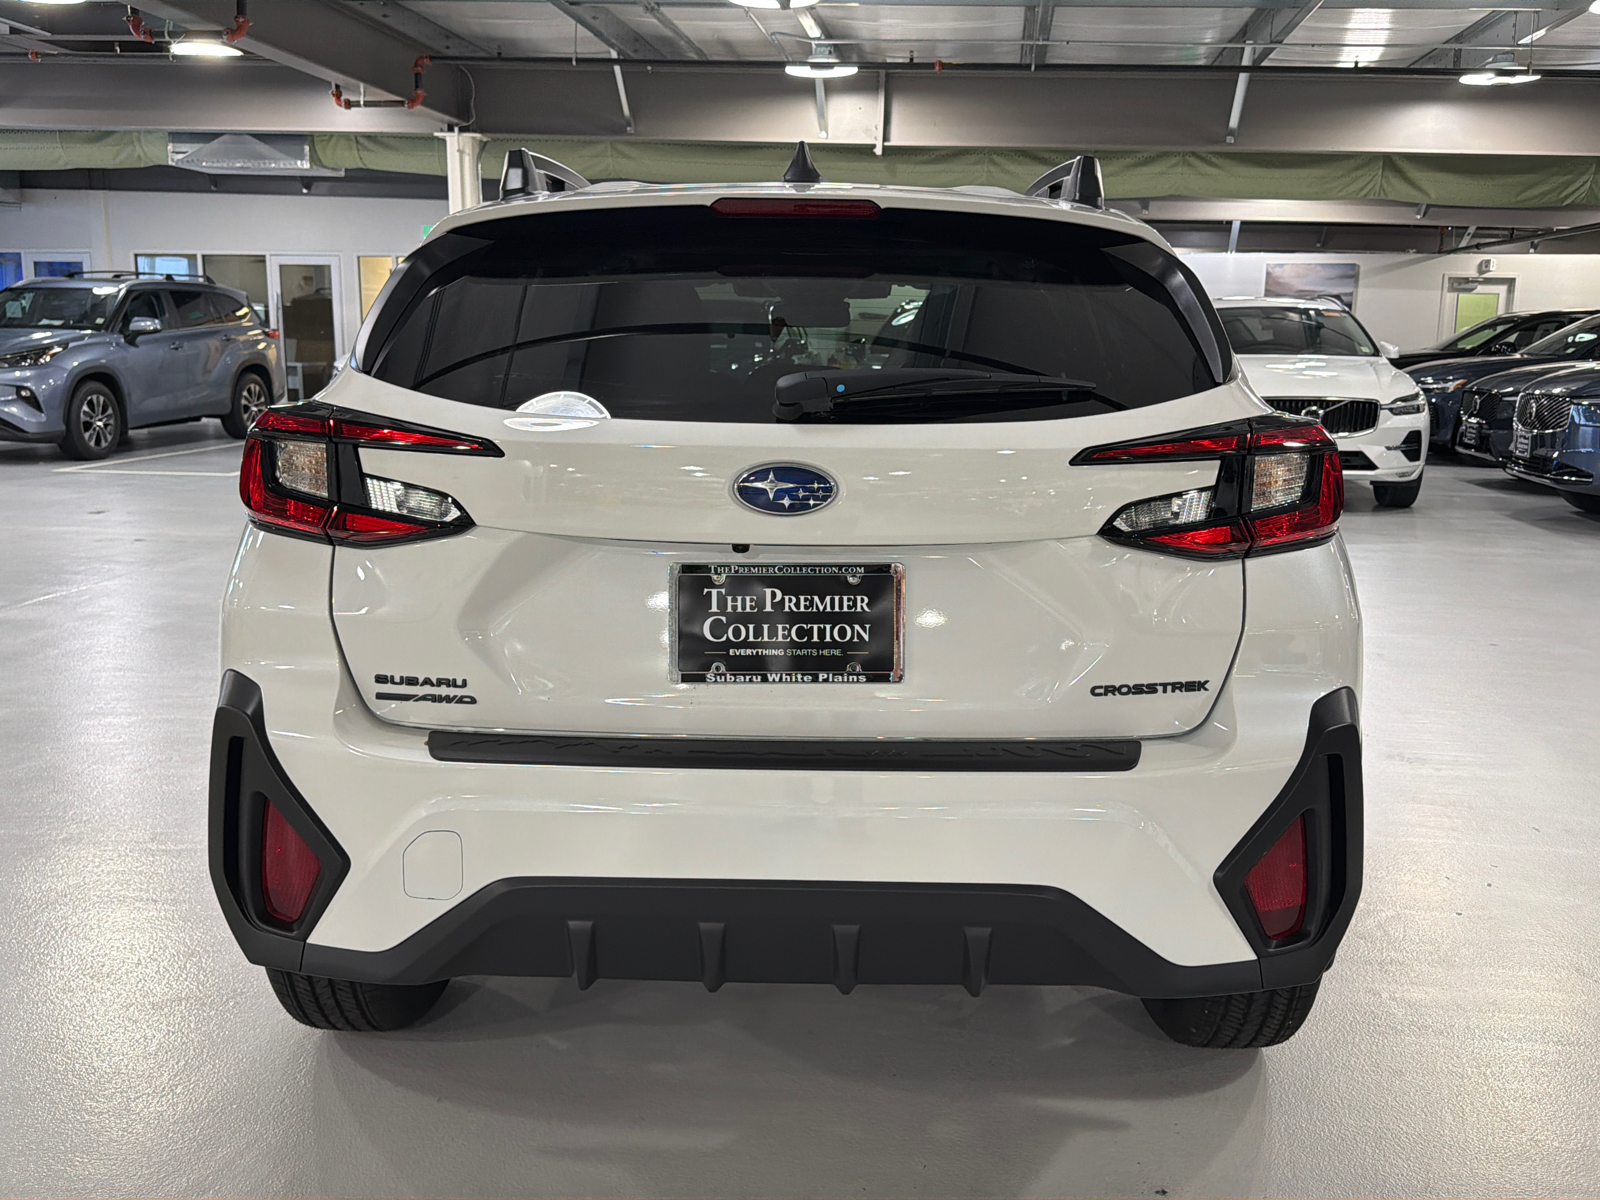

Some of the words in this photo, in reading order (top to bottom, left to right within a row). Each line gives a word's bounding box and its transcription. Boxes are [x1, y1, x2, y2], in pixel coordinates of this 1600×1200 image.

[703, 588, 757, 612] THE
[763, 588, 870, 612] PREMIER
[703, 616, 870, 642] COLLECTION
[374, 674, 467, 688] SUBARU
[706, 673, 761, 682] Subaru
[767, 673, 812, 682] White
[818, 673, 866, 682] Plains
[1090, 680, 1209, 697] CROSSTREK
[412, 693, 477, 704] AWD
